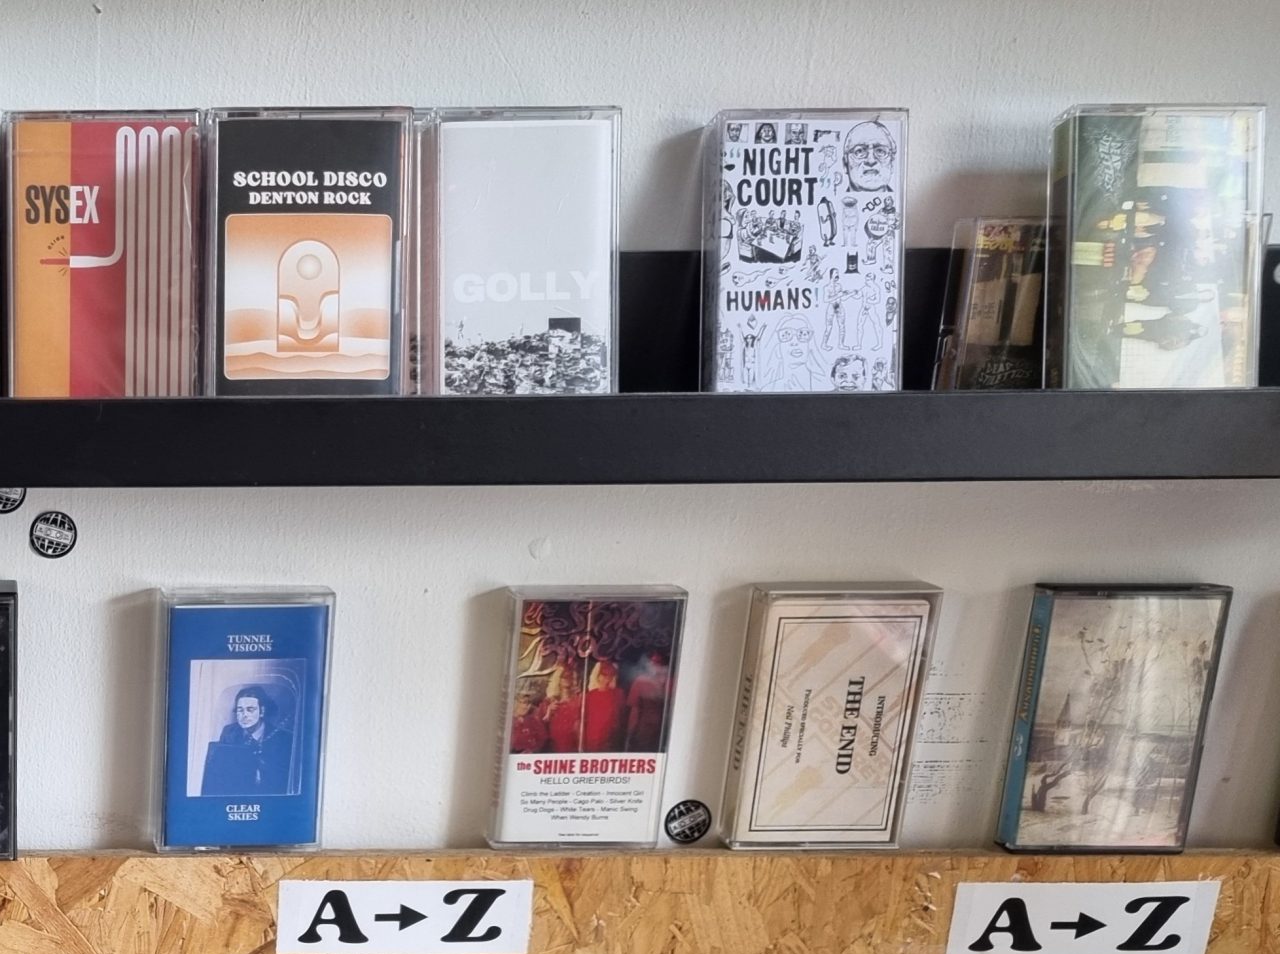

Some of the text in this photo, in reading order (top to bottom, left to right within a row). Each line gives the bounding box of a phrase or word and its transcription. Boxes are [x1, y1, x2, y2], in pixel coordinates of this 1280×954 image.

[743, 148, 814, 176] NIGHT
[233, 172, 387, 188] SCHOOL DISCO
[737, 178, 817, 206] COURT
[26, 185, 100, 225] SYSEX
[249, 192, 371, 205] DENTON ROCK
[453, 271, 599, 302] GOLLY
[227, 635, 273, 643] TUNNEL
[227, 644, 273, 652] VISIONS
[836, 676, 865, 774] THE ENID
[869, 696, 886, 756] INTRODUCING
[517, 759, 656, 774] the SHINE BROTHERS
[226, 805, 261, 813] CLEAR
[228, 813, 258, 821] SKIES
[297, 889, 506, 943] A Z
[969, 896, 1190, 952] A Z
